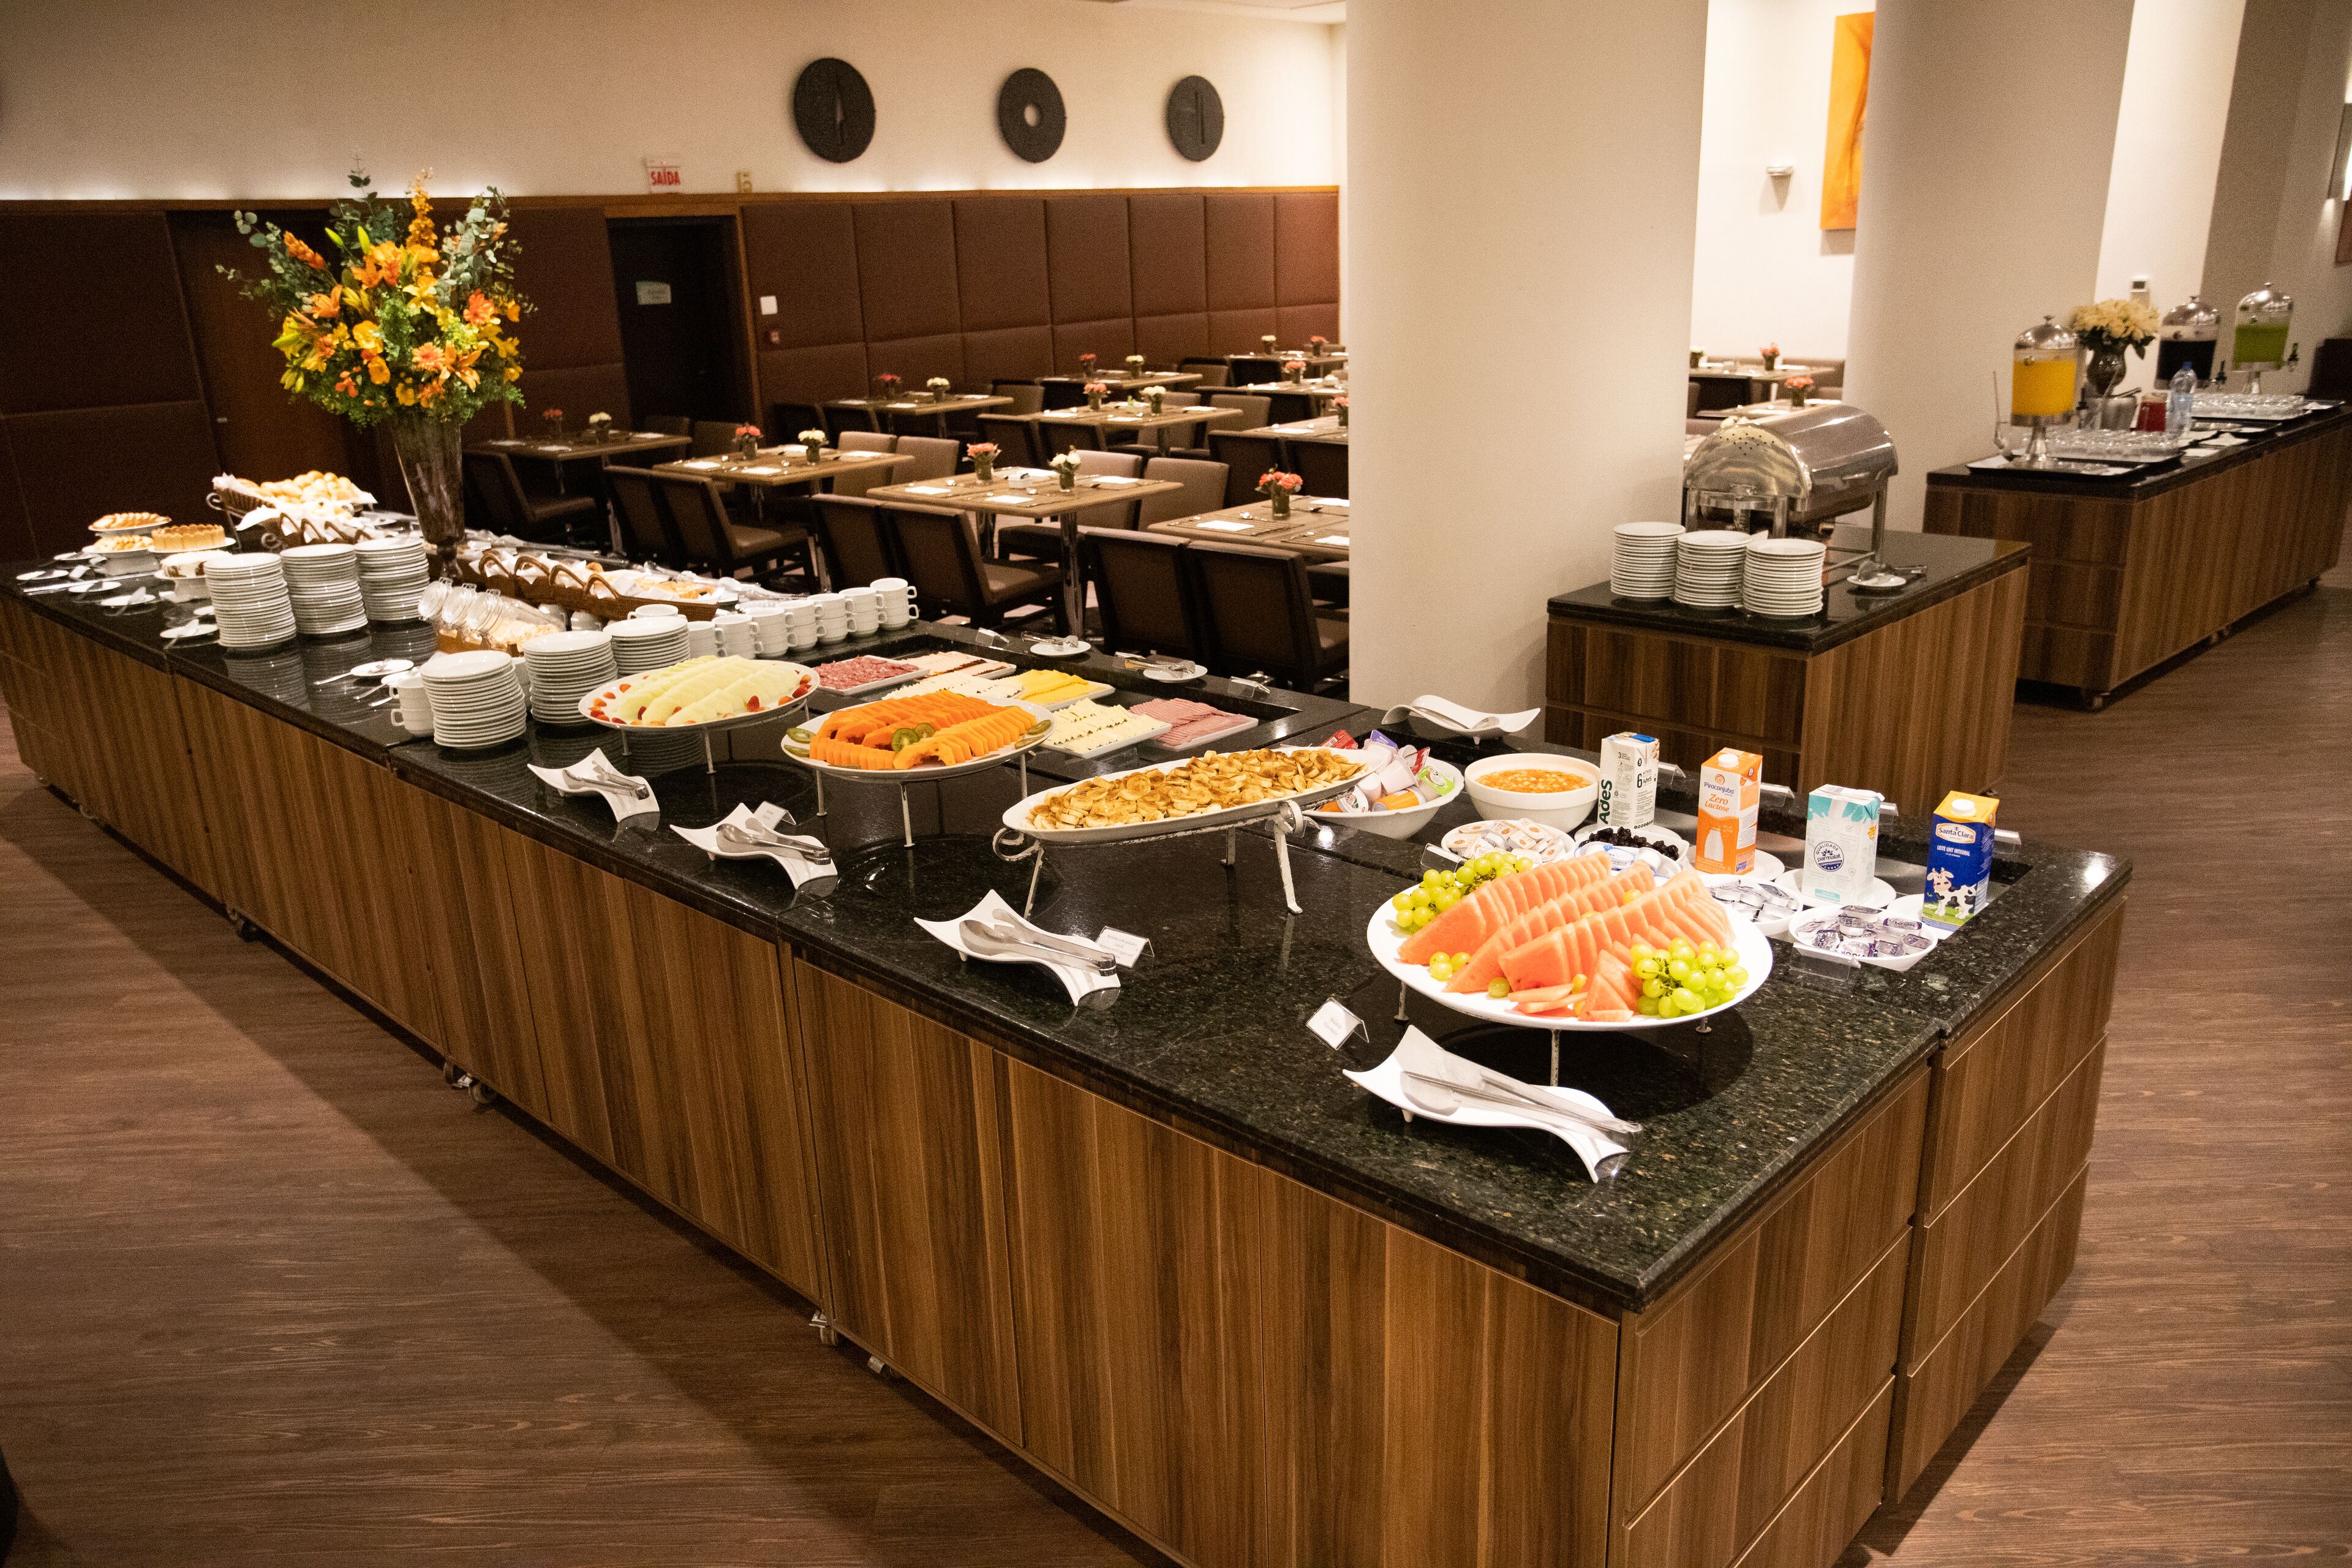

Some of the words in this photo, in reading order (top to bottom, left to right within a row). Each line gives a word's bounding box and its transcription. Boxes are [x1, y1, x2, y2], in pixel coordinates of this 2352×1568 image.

[1637, 773, 1643, 788] 6
[1704, 782, 1734, 794] Piracanjuba
[1709, 793, 1728, 805] Zero
[1705, 800, 1730, 812] Lactose
[1939, 827, 1956, 836] Santa
[1957, 831, 1973, 839] Clara
[1815, 843, 1839, 855] QUALIDADE
[1817, 854, 1841, 862] parmalat
